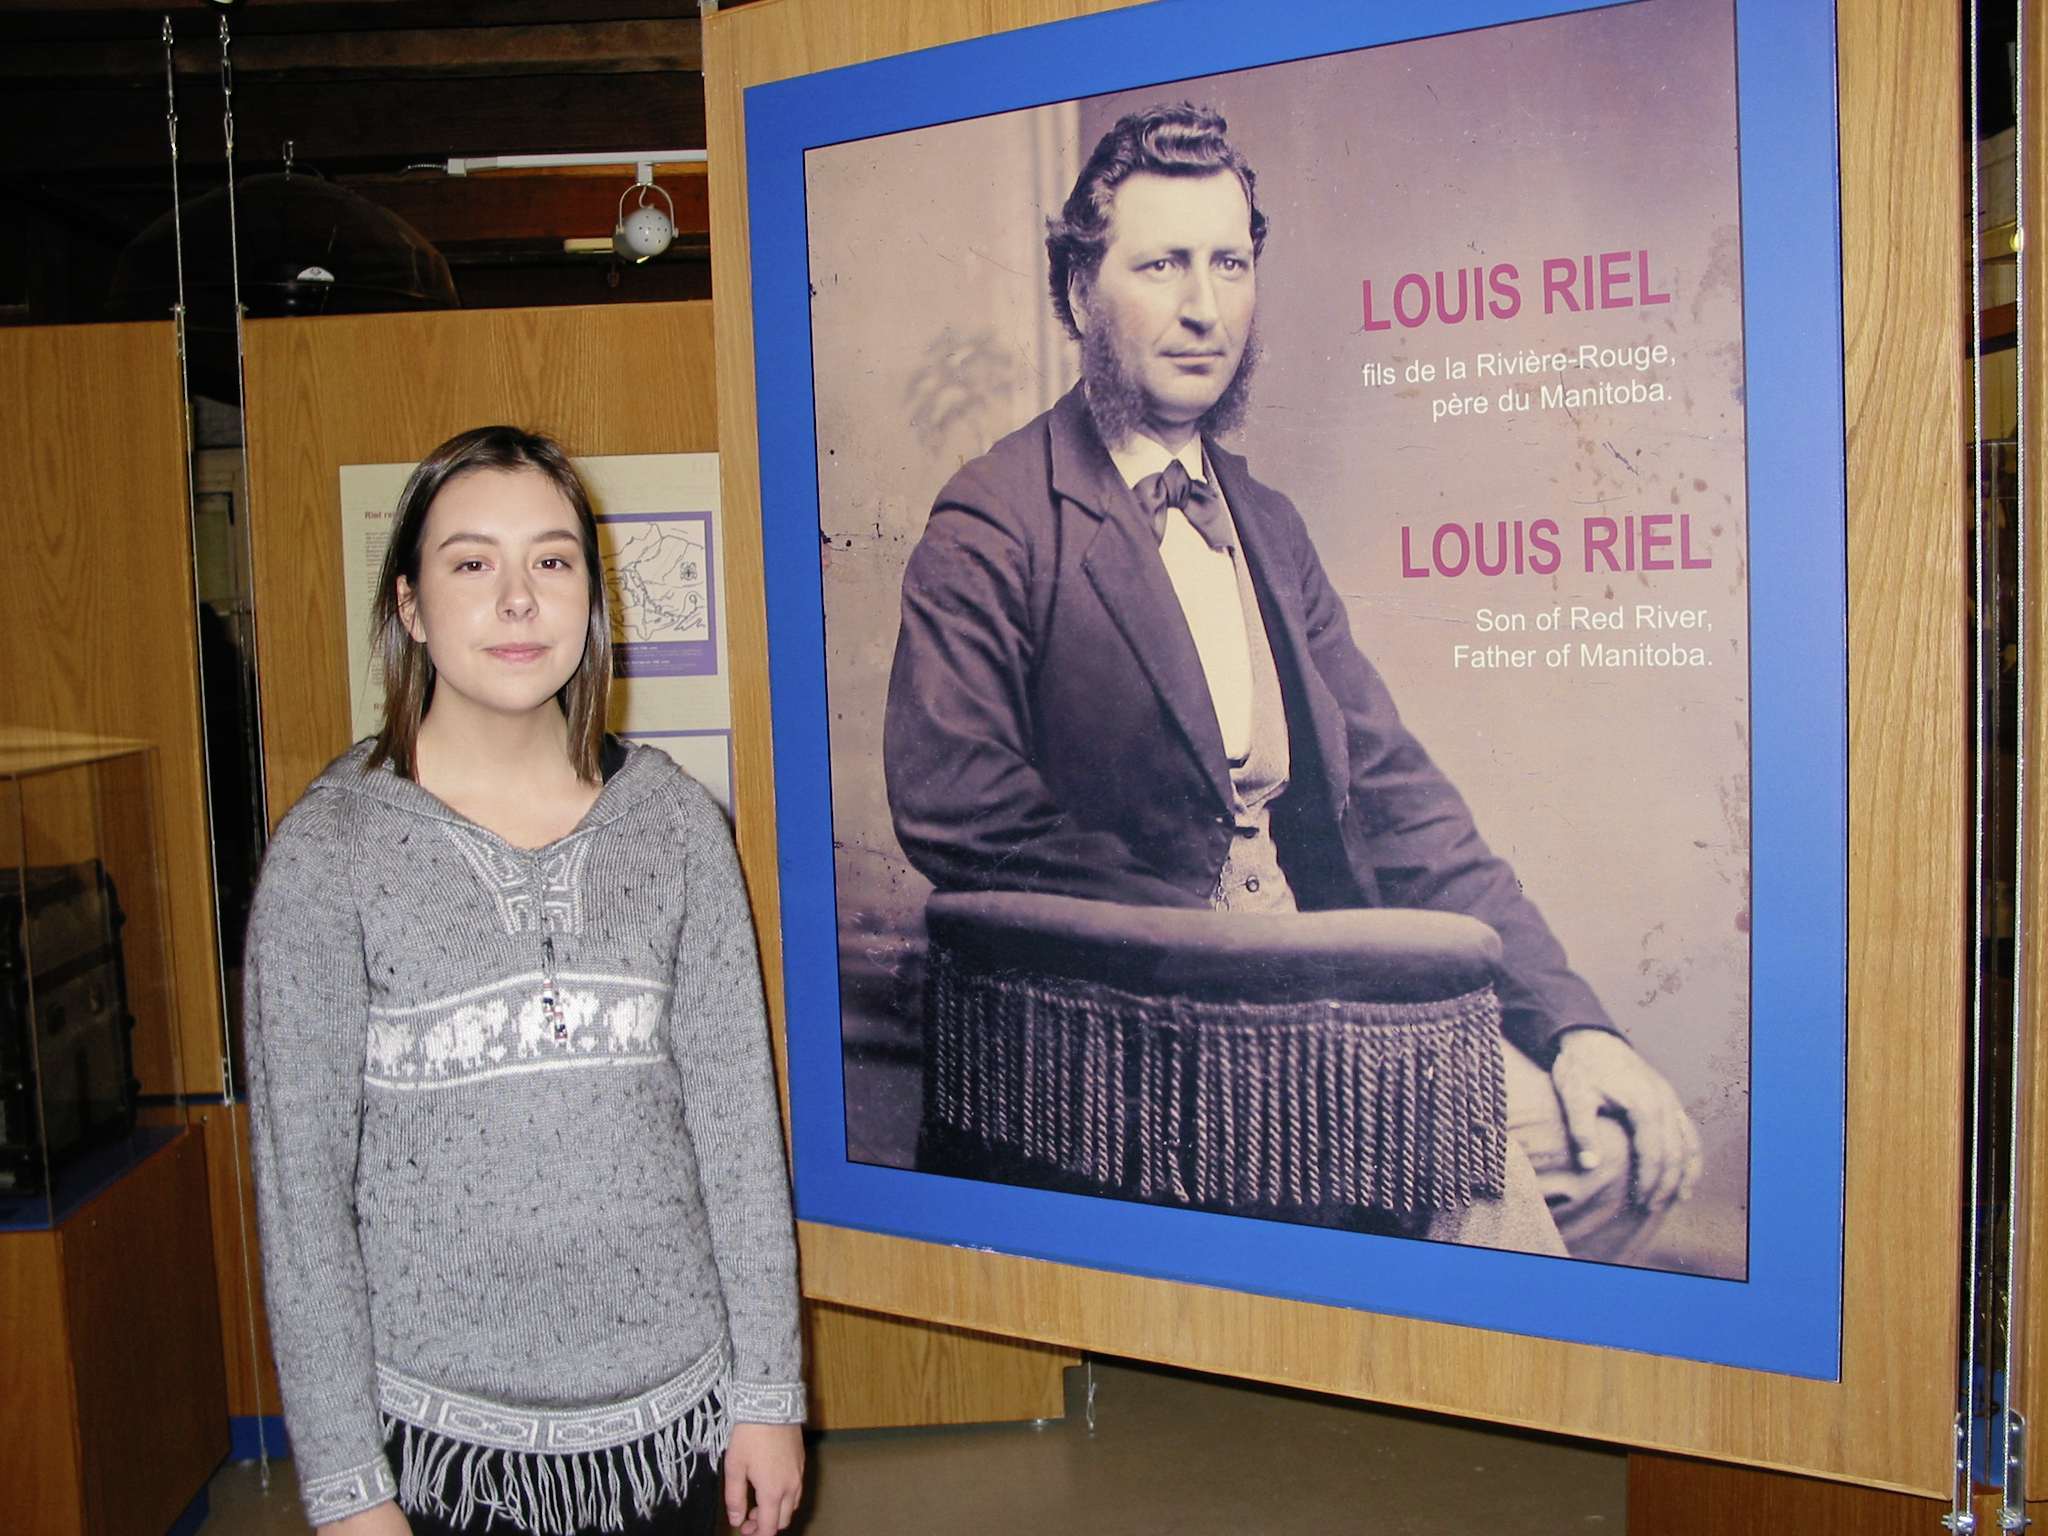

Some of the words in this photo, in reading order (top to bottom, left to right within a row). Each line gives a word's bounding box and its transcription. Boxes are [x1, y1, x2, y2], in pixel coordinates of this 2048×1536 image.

[1362, 263, 1521, 331] LOUIS
[1543, 250, 1671, 315] RIEL
[1362, 363, 1396, 387] fils
[1405, 359, 1435, 383] de
[1446, 357, 1466, 380] la
[1477, 343, 1676, 377] Rivière-Rouge,
[1432, 394, 1488, 423] père
[1498, 389, 1529, 412] du
[1540, 380, 1672, 409] Manitoba.
[1401, 519, 1561, 578] LOUIS
[1584, 514, 1712, 572] RIEL
[1476, 608, 1526, 632] Son
[1536, 607, 1560, 631] of
[1570, 606, 1624, 630] Red
[1635, 605, 1712, 631] River,
[1454, 644, 1536, 668] Father
[1546, 643, 1570, 667] of
[1580, 643, 1712, 667] Manitoba.
